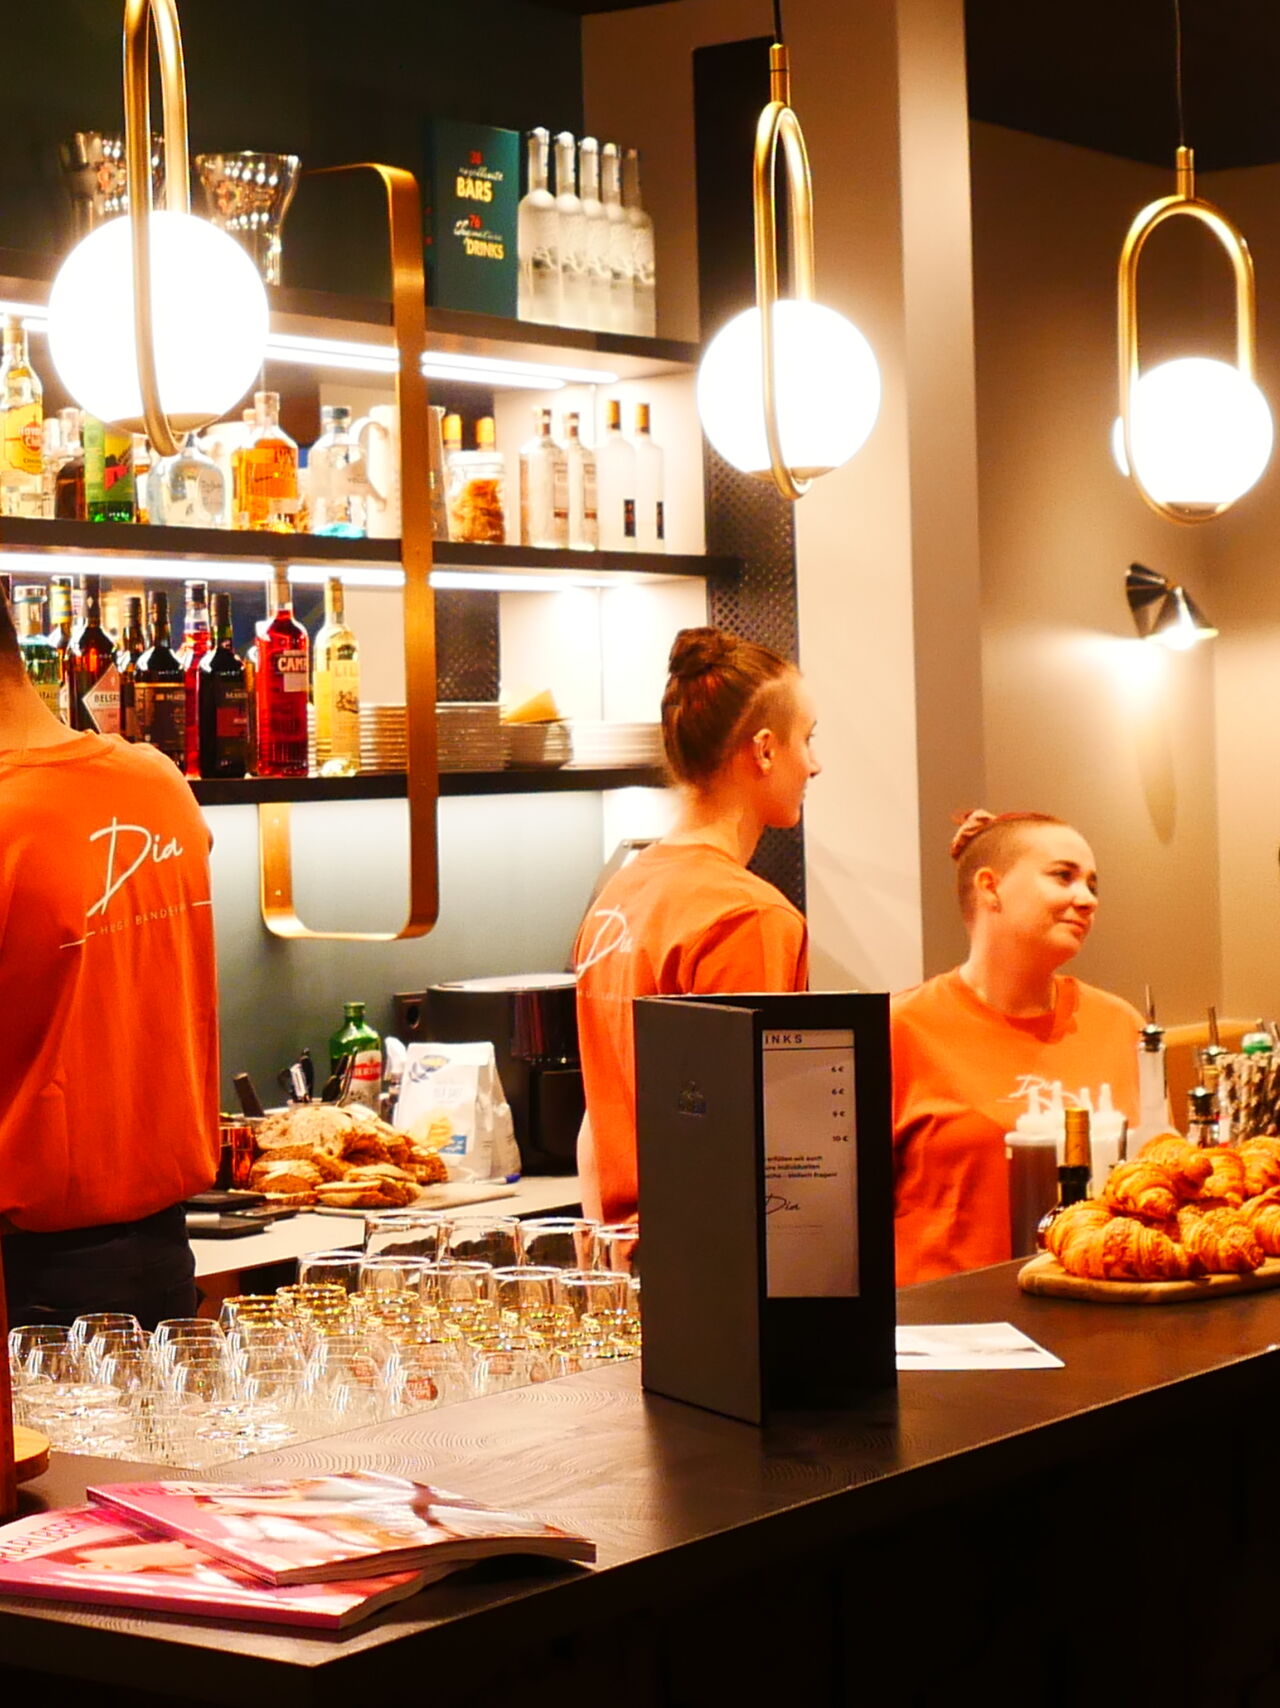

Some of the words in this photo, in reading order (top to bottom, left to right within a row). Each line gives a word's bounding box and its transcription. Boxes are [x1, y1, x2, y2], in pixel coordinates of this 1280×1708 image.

[457, 176, 493, 202] BARS
[465, 238, 504, 260] DRINKS
[85, 816, 184, 918] Dia
[765, 1034, 803, 1044] INKS
